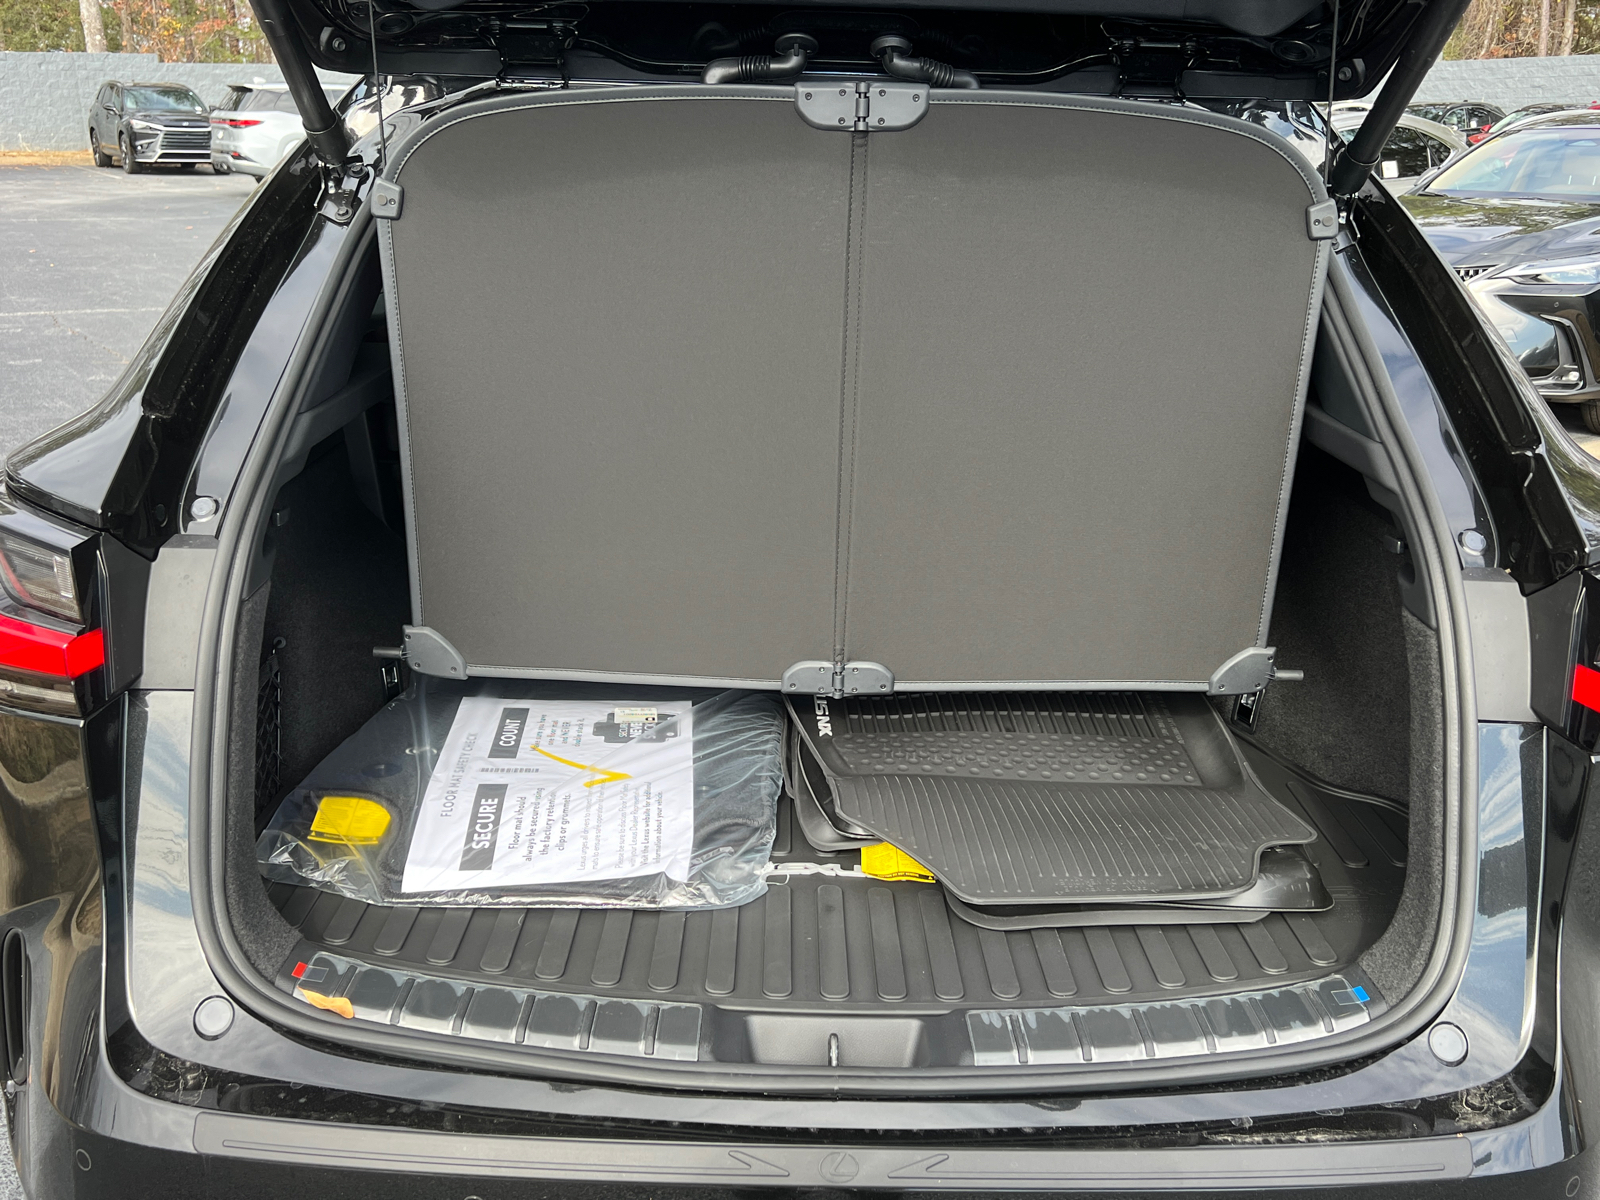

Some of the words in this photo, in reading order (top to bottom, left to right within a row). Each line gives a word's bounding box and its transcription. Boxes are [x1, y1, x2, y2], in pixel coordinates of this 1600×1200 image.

[499, 718, 520, 745] COUNT
[629, 722, 642, 737] NEVE
[816, 715, 833, 737] NX
[463, 732, 478, 751] CHECK
[454, 752, 470, 773] SAFETY
[449, 774, 462, 787] MAT
[441, 790, 458, 816] FLOOR
[514, 796, 526, 815] should
[561, 793, 572, 824] grommets.
[531, 801, 540, 826] secured
[472, 798, 498, 849] SECURE
[514, 817, 523, 830] mat
[527, 828, 536, 836] be
[541, 818, 555, 842] factory
[560, 826, 566, 834] or
[508, 831, 520, 849] Floor
[556, 835, 567, 850] clips
[629, 831, 637, 845] Lexus
[642, 828, 650, 843] Lexus
[523, 838, 537, 861] always
[539, 843, 550, 855] the
[578, 855, 586, 870] Lexus
[615, 852, 624, 868] Please
